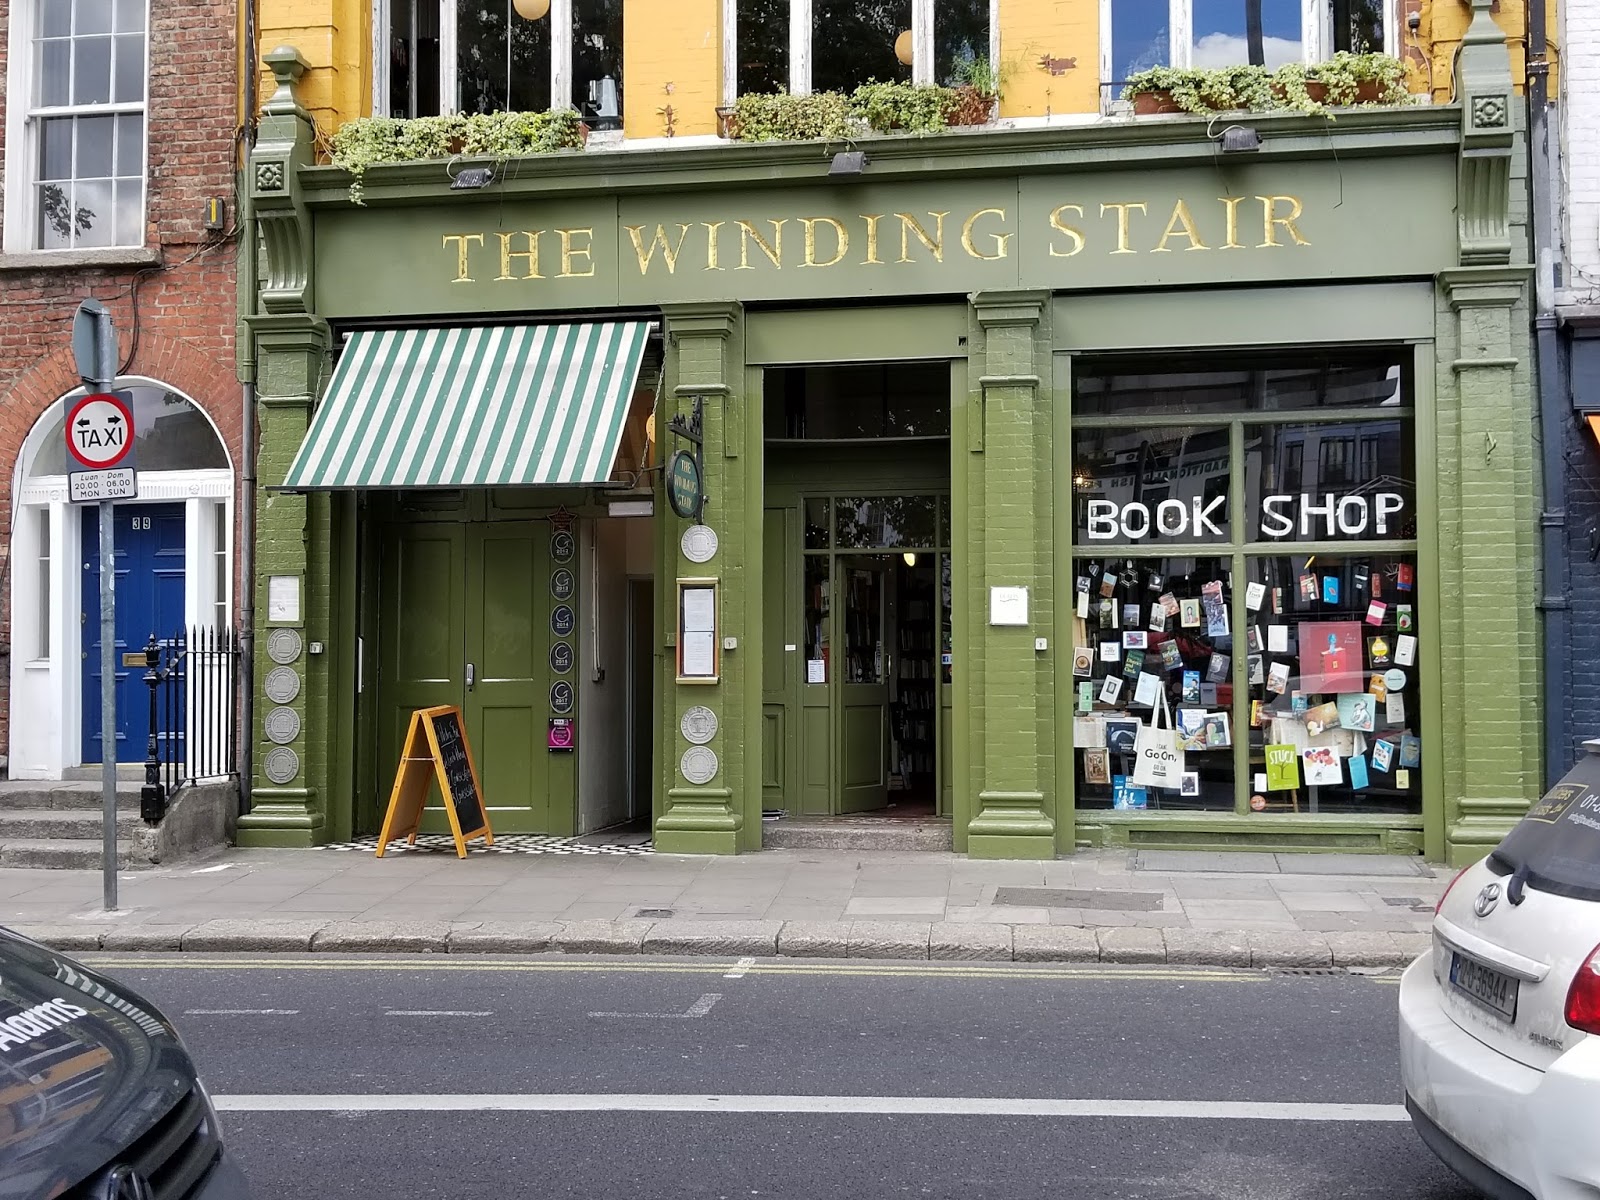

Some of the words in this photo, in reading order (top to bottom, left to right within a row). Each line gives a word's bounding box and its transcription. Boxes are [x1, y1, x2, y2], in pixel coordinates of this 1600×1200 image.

[442, 226, 595, 283] THE
[623, 208, 1014, 276] WINDING
[1048, 195, 1312, 257] STAIR
[77, 427, 123, 448] TAXI
[74, 481, 99, 490] 20.00
[106, 479, 130, 487] 06.00
[80, 490, 100, 498] MON
[132, 517, 151, 529] 39
[1087, 495, 1226, 539] BOOK
[1261, 493, 1404, 537] SHOP
[1144, 748, 1160, 760] Go
[1268, 749, 1295, 765] STUCK
[0, 998, 87, 1052] Alarms
